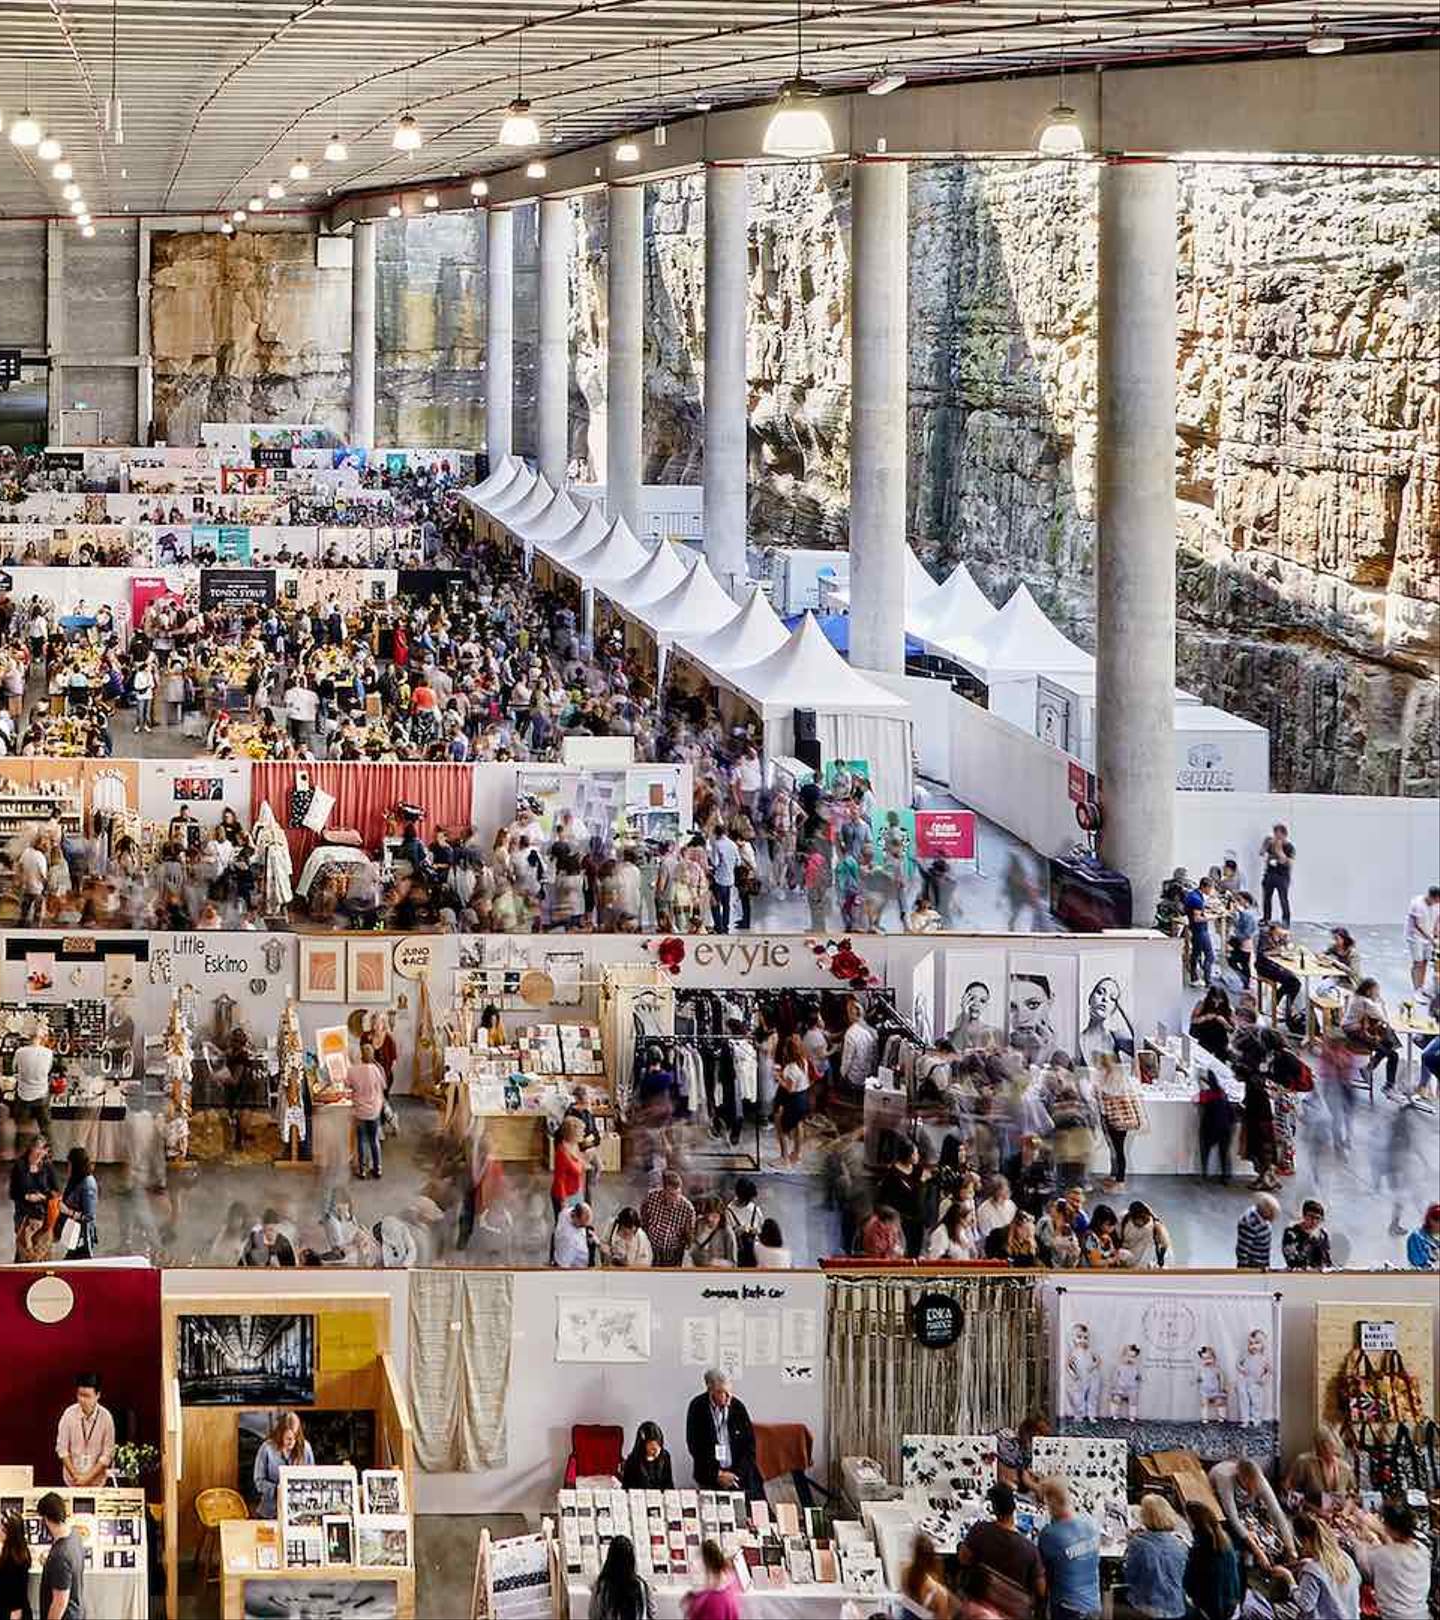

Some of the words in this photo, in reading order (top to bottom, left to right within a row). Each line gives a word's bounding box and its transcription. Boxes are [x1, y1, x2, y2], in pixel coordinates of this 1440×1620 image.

[210, 589, 238, 597] TONIC
[240, 589, 266, 597] SYRUP
[173, 935, 205, 954] Little
[402, 947, 430, 956] JUNO
[205, 954, 248, 973] Eskimo
[694, 938, 790, 975] evyie
